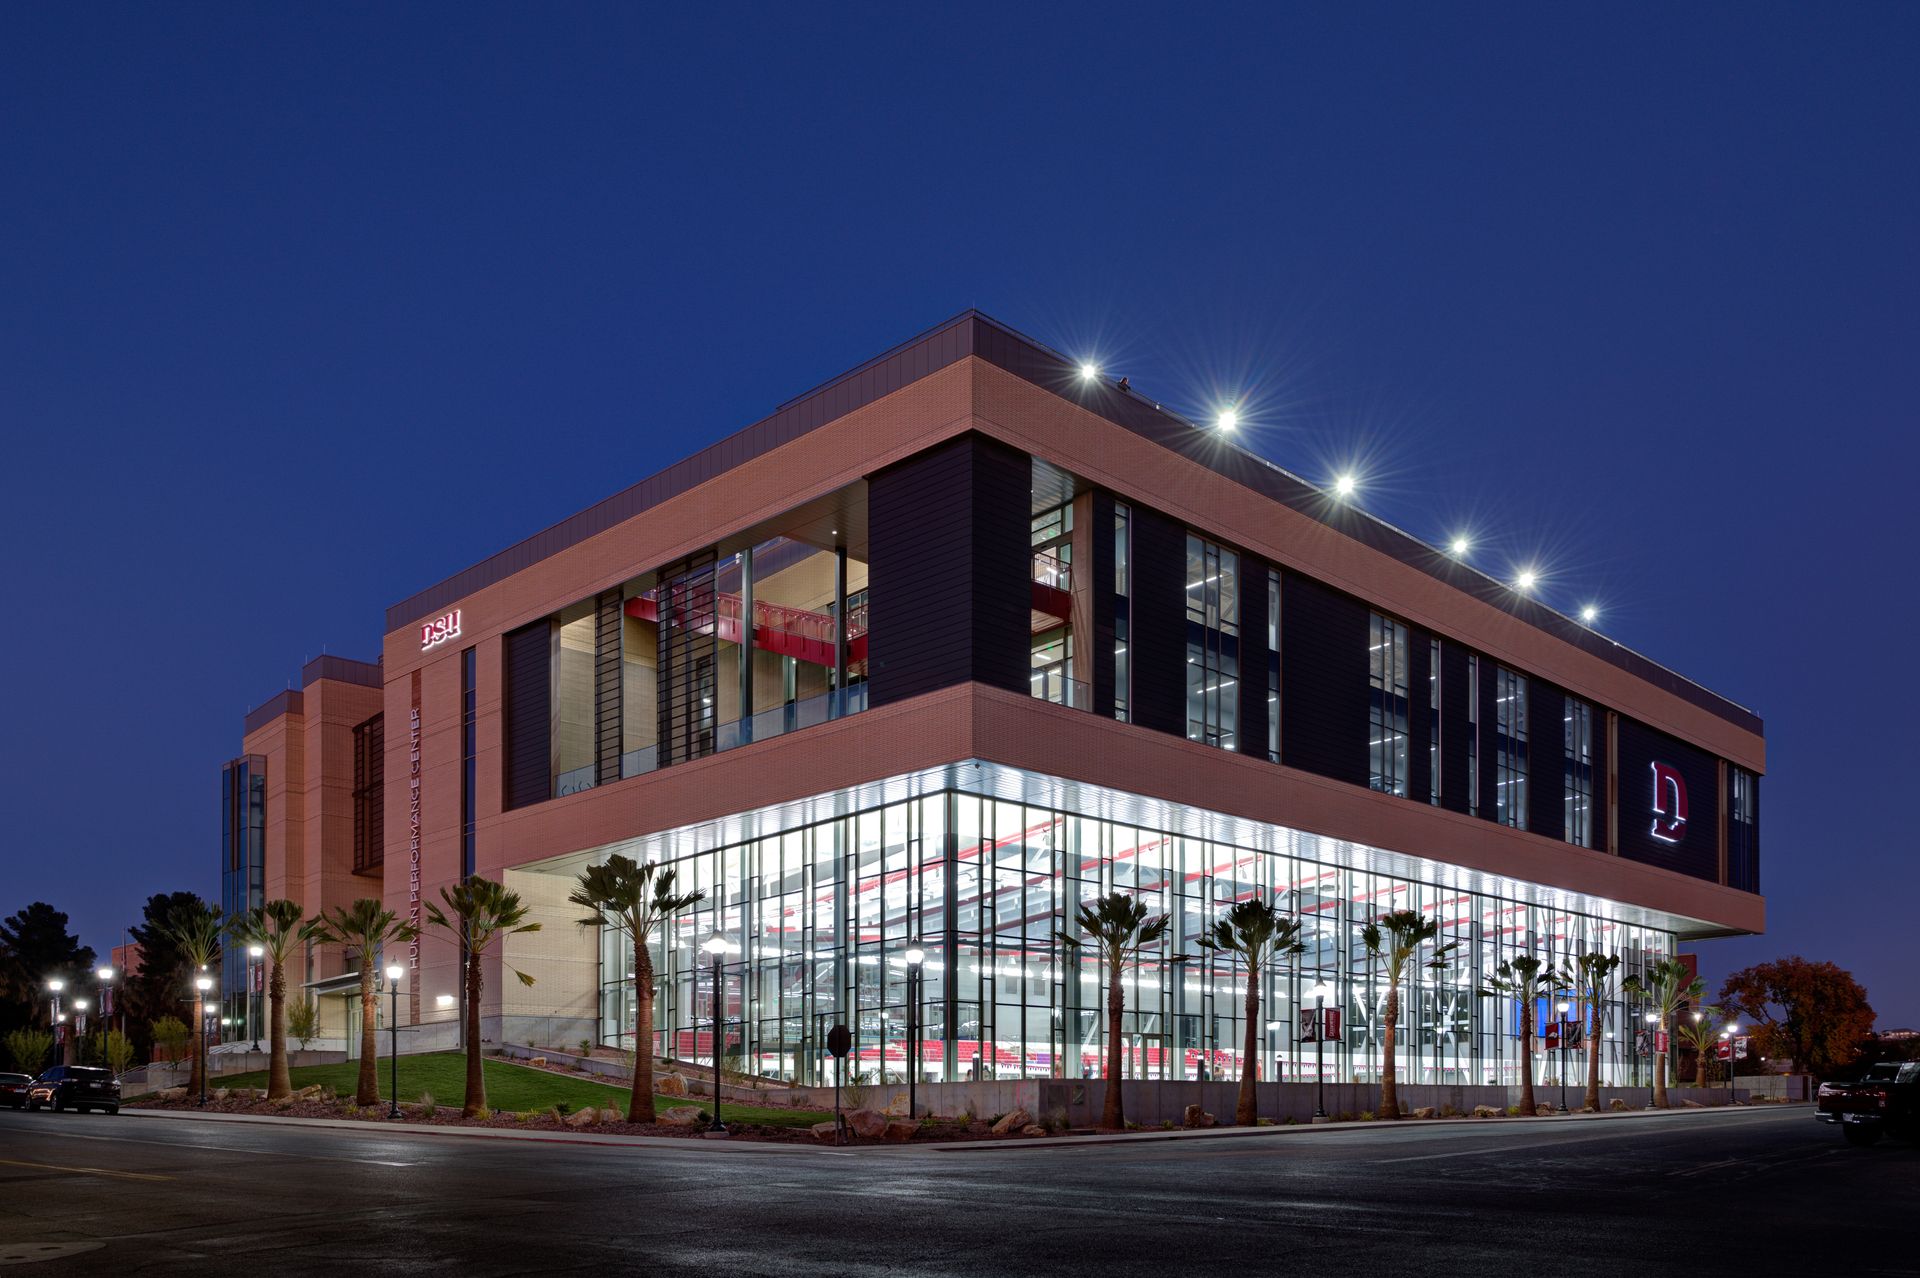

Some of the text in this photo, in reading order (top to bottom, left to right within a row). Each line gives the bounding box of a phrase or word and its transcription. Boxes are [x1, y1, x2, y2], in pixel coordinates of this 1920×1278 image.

[421, 609, 461, 651] DSU
[410, 707, 420, 774] CENTER
[1650, 761, 1689, 843] D
[410, 777, 420, 902] PERFORMANCE
